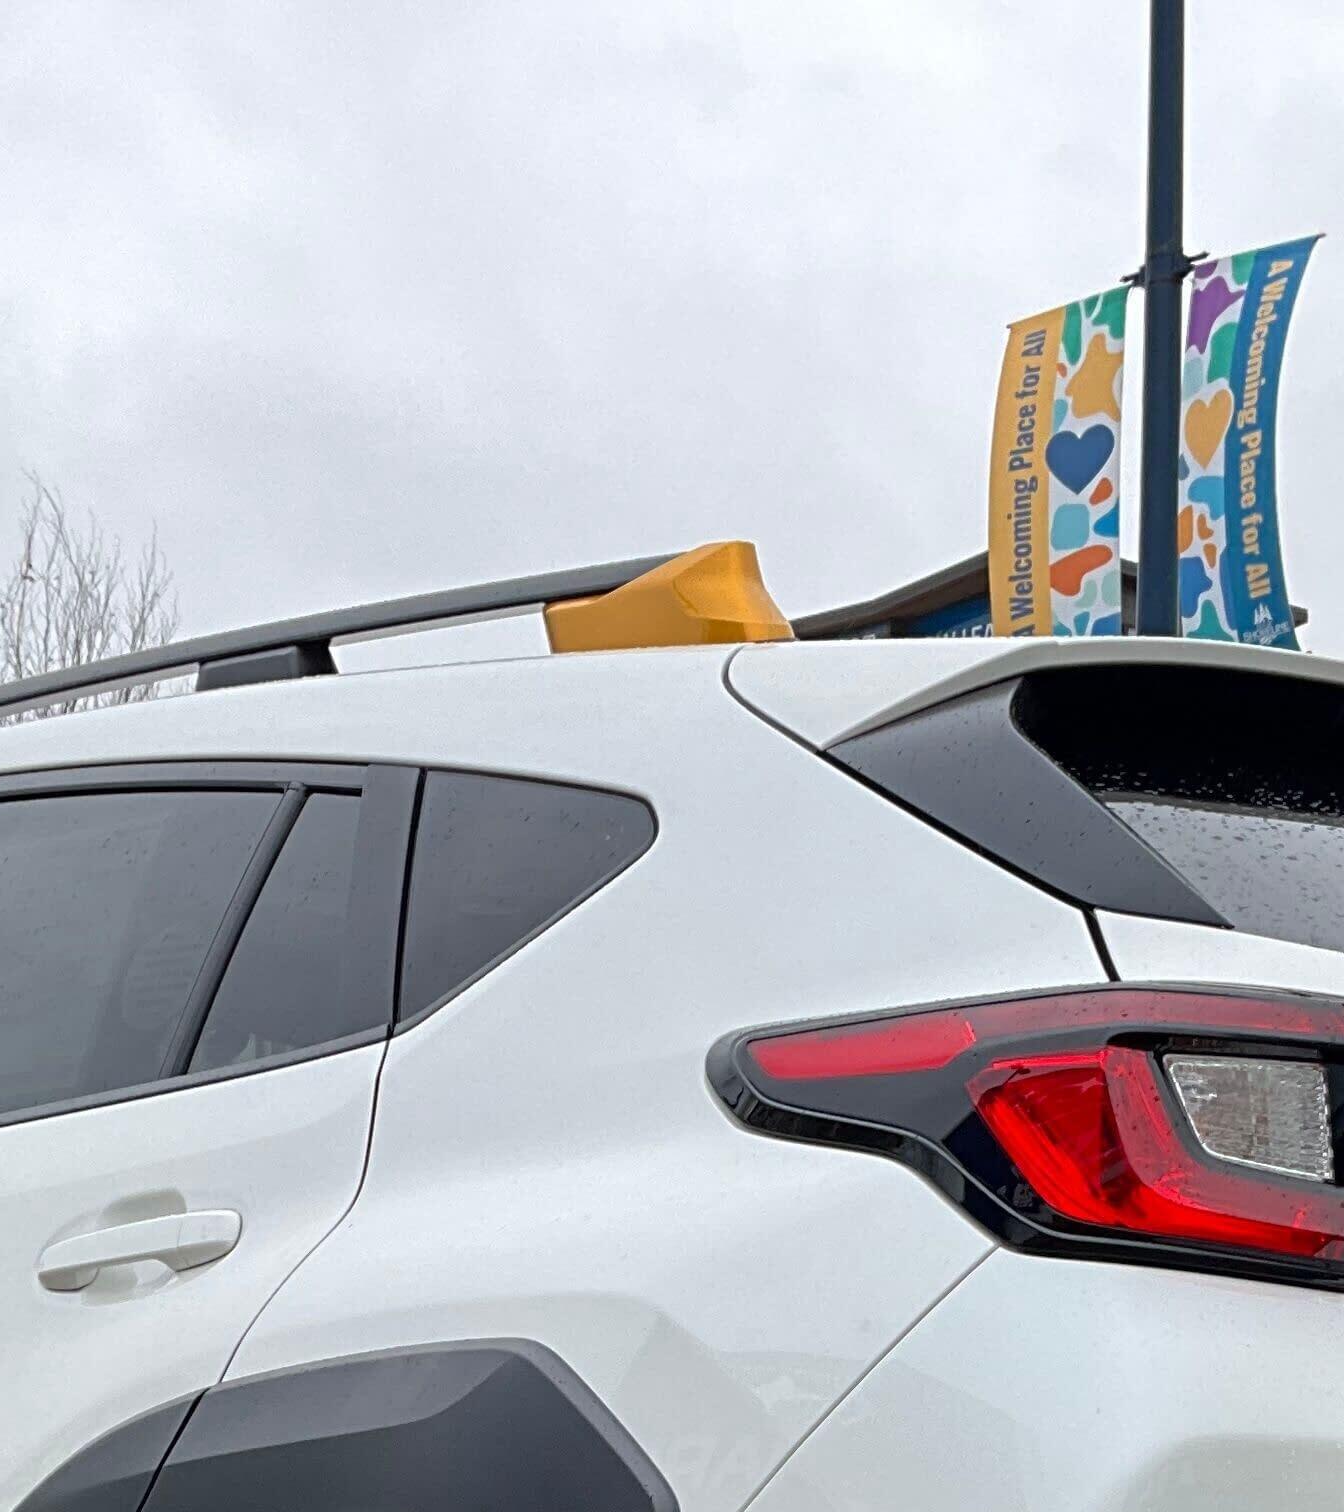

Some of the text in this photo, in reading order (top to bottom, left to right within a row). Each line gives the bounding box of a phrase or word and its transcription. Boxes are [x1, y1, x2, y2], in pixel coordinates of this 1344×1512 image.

[1267, 260, 1294, 278] A
[1021, 329, 1047, 357] All
[1237, 277, 1288, 429] Welcoming
[1015, 364, 1041, 399] for
[1008, 403, 1037, 472] Place
[1240, 429, 1263, 509] Place
[1007, 475, 1039, 621] Welcoming
[1241, 513, 1264, 555] for
[1245, 563, 1272, 599] All
